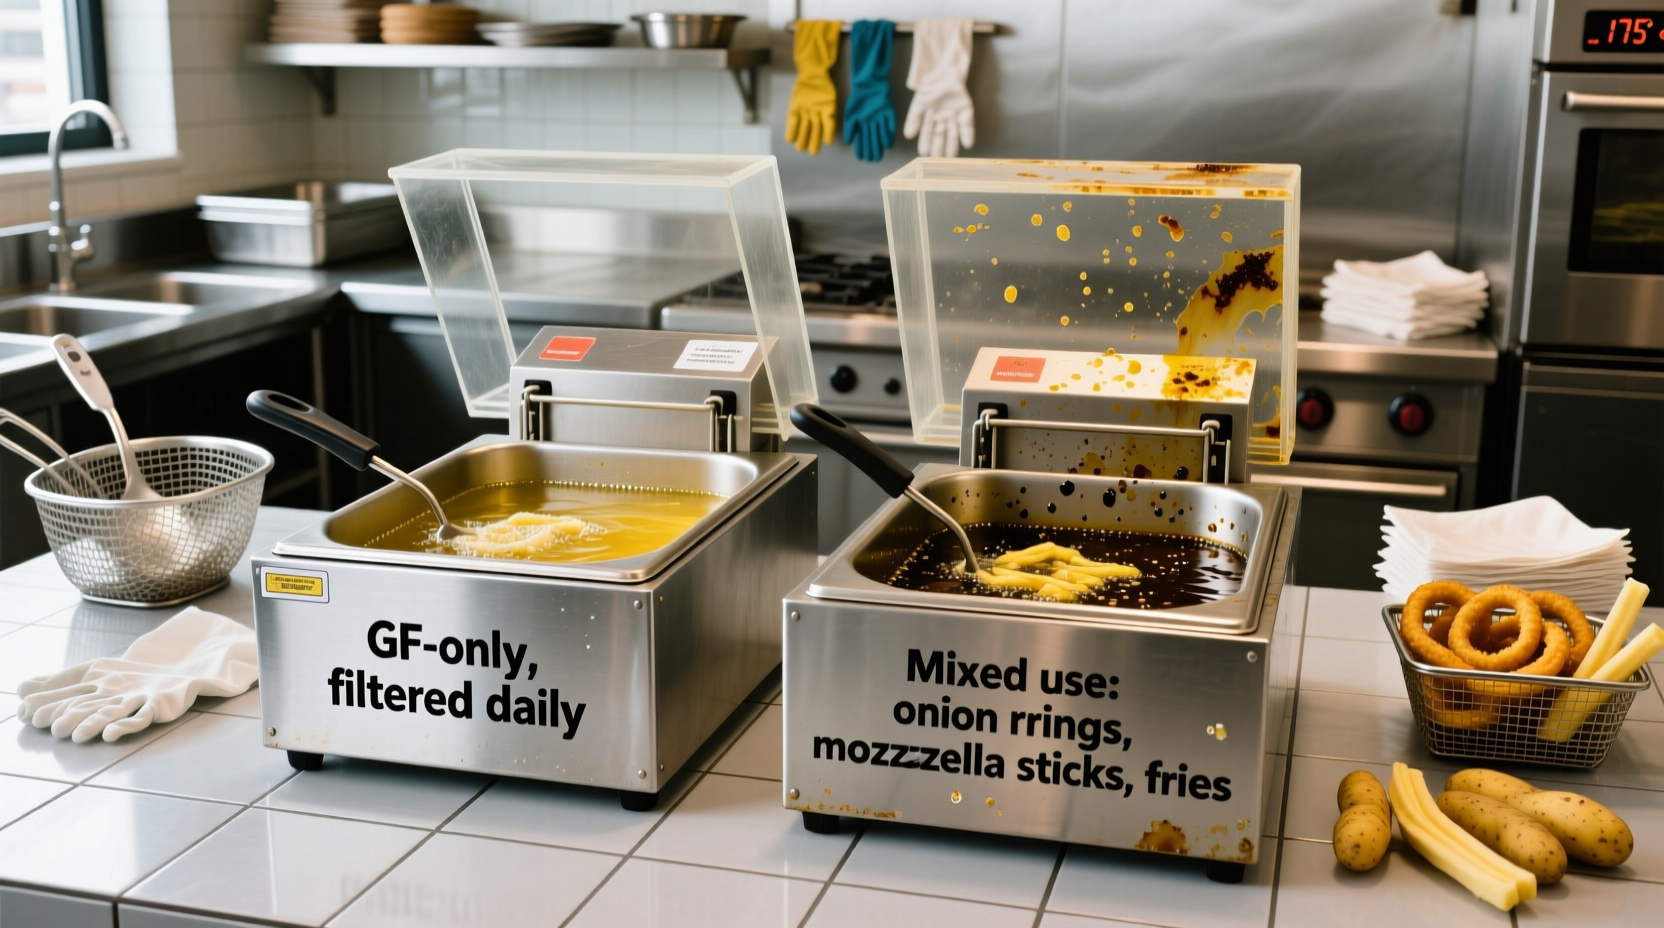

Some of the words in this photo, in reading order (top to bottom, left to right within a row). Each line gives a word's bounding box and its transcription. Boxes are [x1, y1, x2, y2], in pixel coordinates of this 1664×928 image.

[367, 620, 538, 681] GF-only,
[906, 648, 1028, 692] Mixed
[1040, 669, 1120, 701] use:
[327, 667, 473, 719] filtered
[486, 684, 587, 741] daily
[893, 695, 998, 734] onion
[1010, 703, 1133, 752] rrings,
[1016, 752, 1134, 799] sticks,
[1144, 759, 1232, 802] fries
